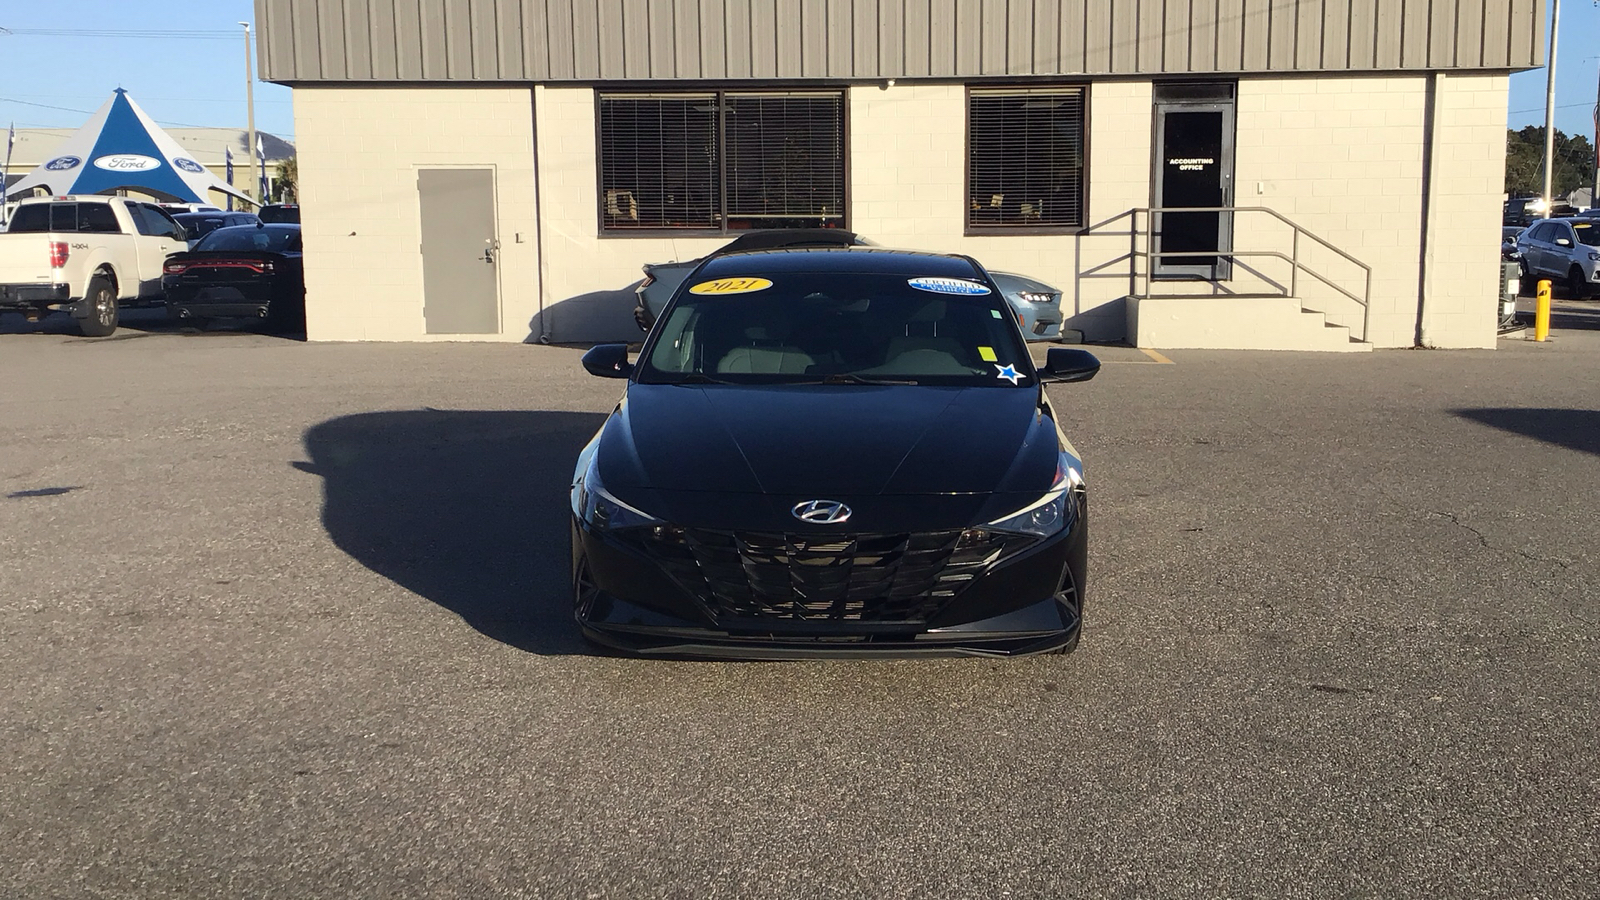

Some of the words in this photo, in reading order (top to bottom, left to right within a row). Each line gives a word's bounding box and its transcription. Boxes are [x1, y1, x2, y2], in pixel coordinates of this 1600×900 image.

[49, 158, 76, 169] Ford
[108, 157, 147, 169] Ford
[178, 159, 201, 171] Ford
[701, 280, 759, 293] 2021
[915, 279, 981, 289] CERTIFIED
